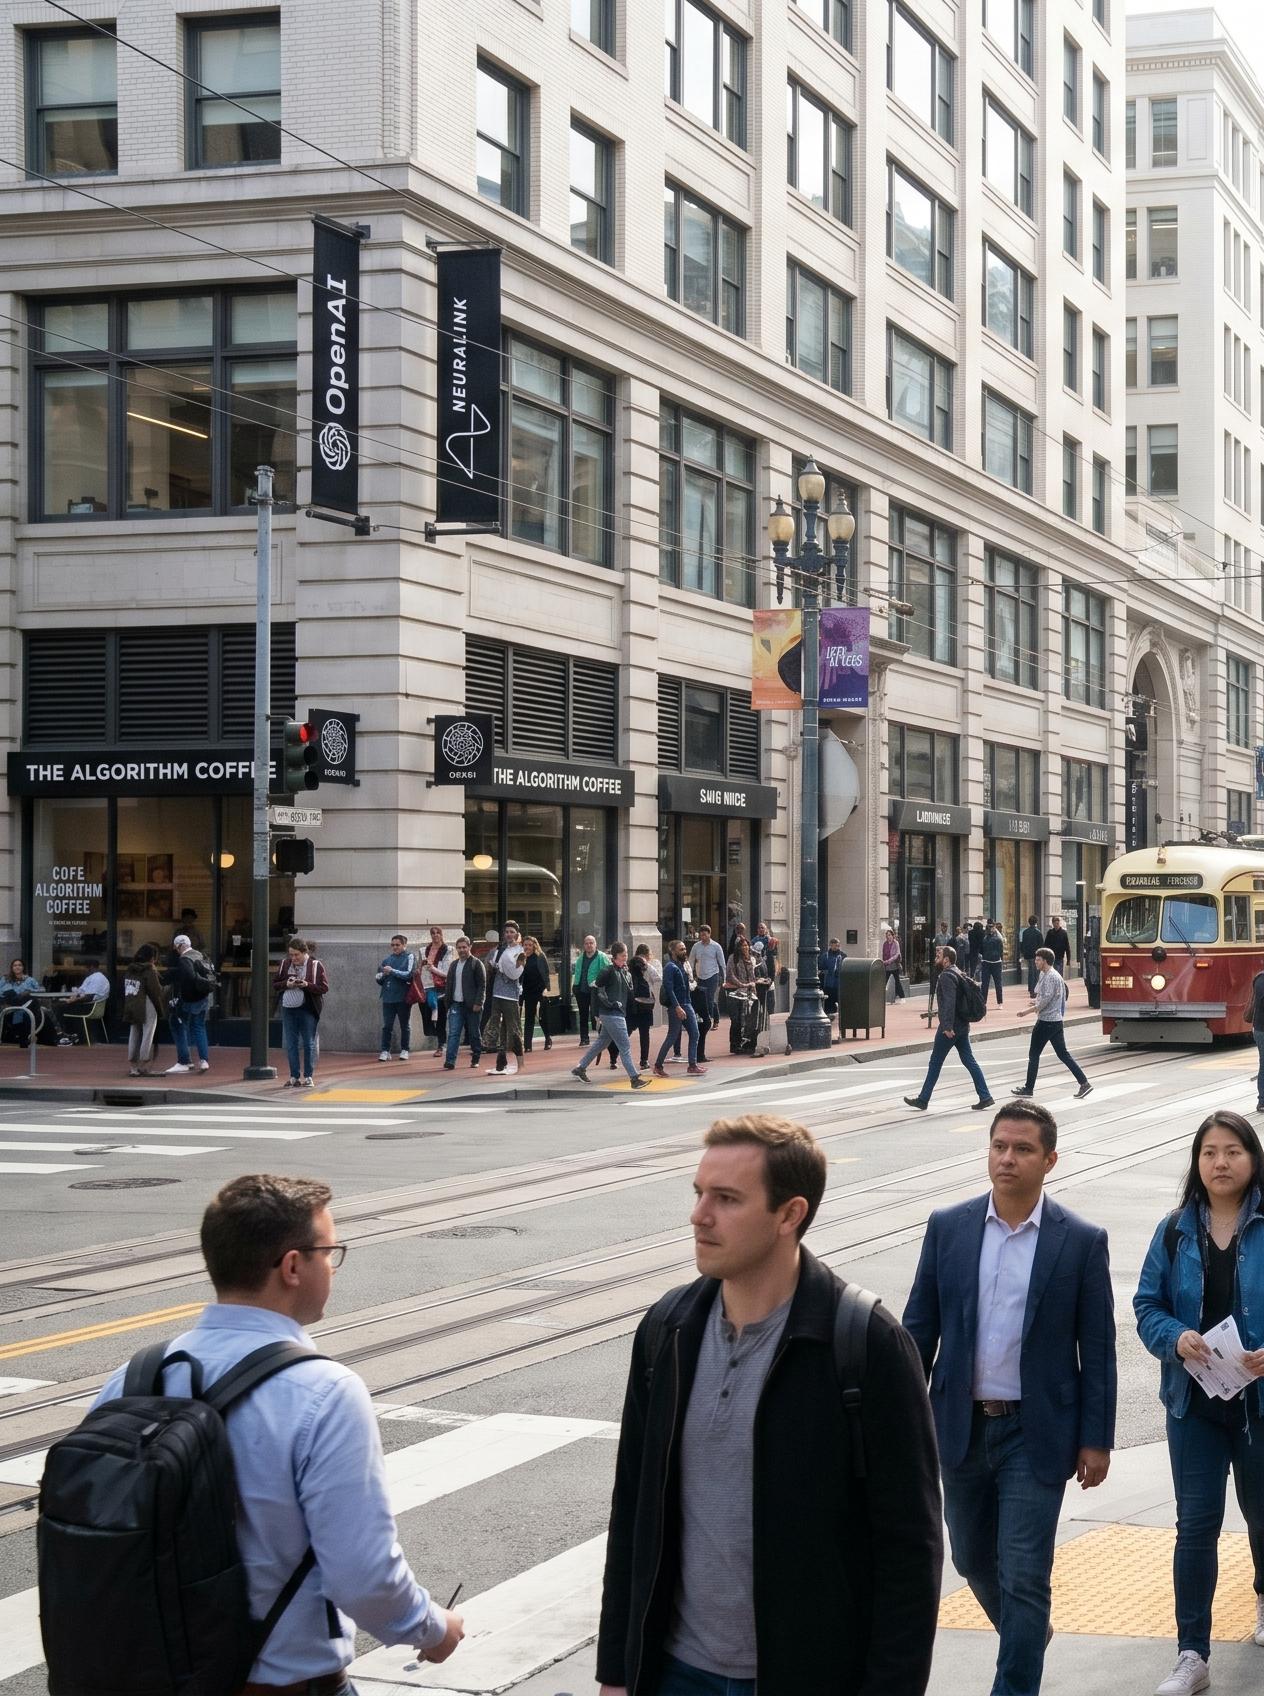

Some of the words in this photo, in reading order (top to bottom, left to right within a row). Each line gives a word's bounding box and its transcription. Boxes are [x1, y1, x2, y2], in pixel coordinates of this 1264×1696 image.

[325, 273, 349, 415] OpenAI
[452, 297, 467, 412] NEURALINK
[26, 764, 64, 781] THE
[70, 762, 188, 781] ALGORITHM
[516, 770, 580, 791] ALGORITHM
[582, 776, 622, 795] COFFEE
[52, 866, 85, 881] COFE
[35, 883, 103, 898] ALGORITHM
[46, 899, 91, 914] COFFEE
